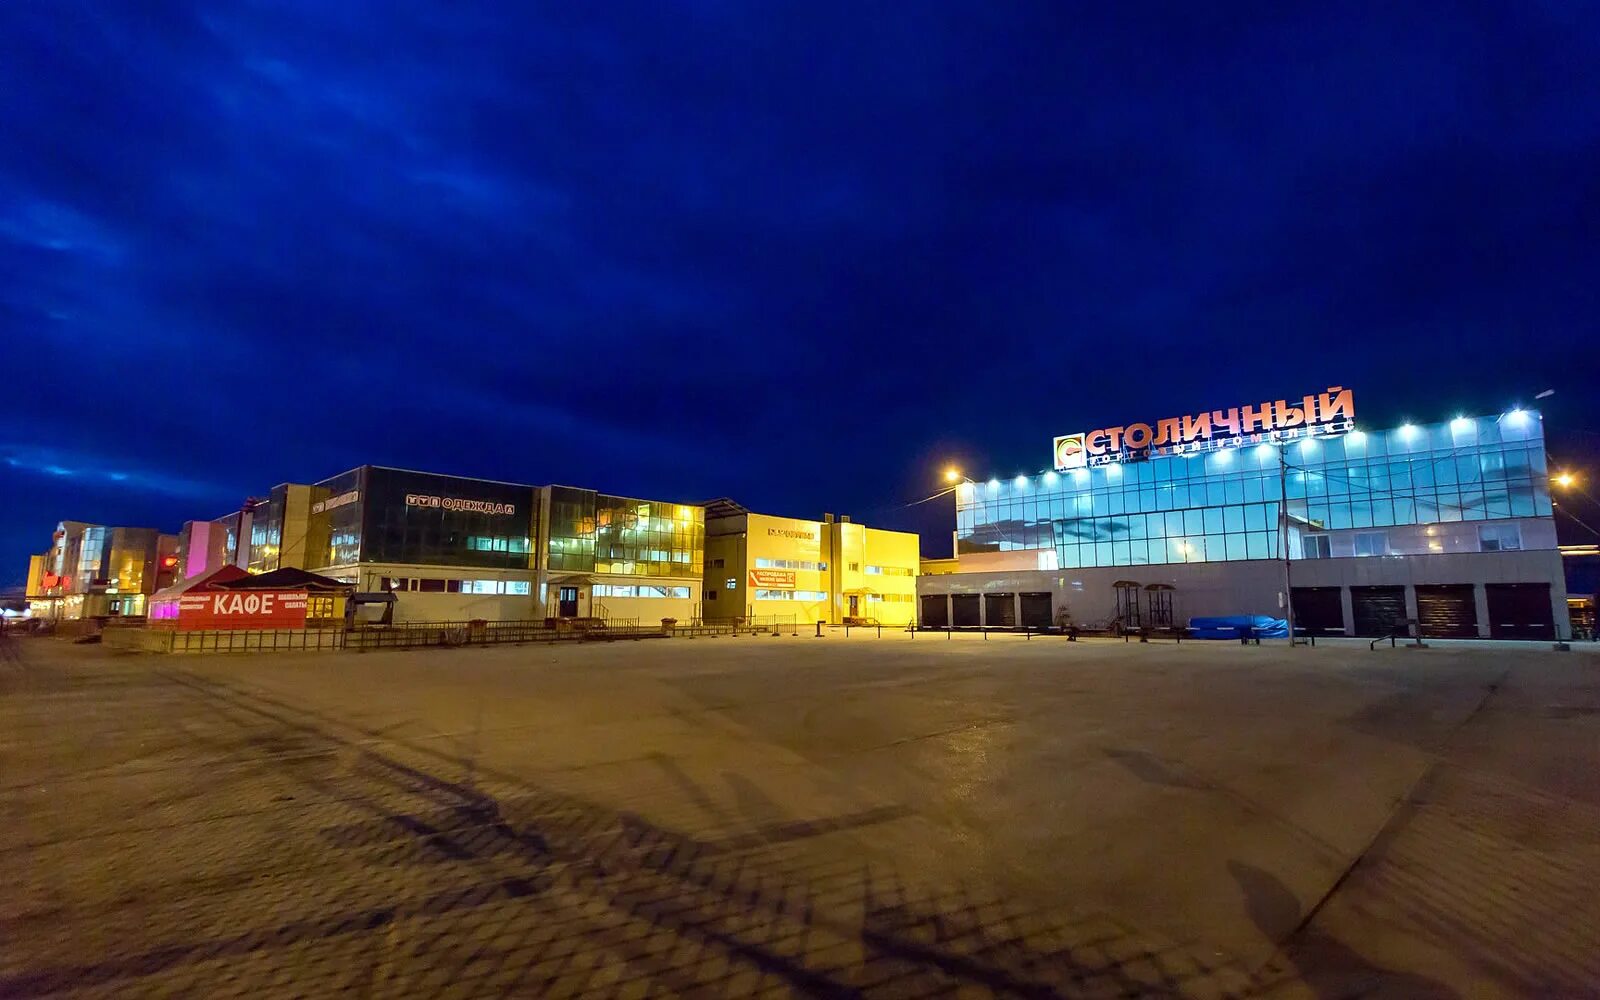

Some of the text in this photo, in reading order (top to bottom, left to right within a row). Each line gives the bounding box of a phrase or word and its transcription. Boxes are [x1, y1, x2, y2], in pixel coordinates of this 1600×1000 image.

[1085, 386, 1355, 455] СТОЛИЧНЫЙ
[441, 497, 504, 514] ОДЕЖДА
[213, 594, 275, 615] КАФЕ
